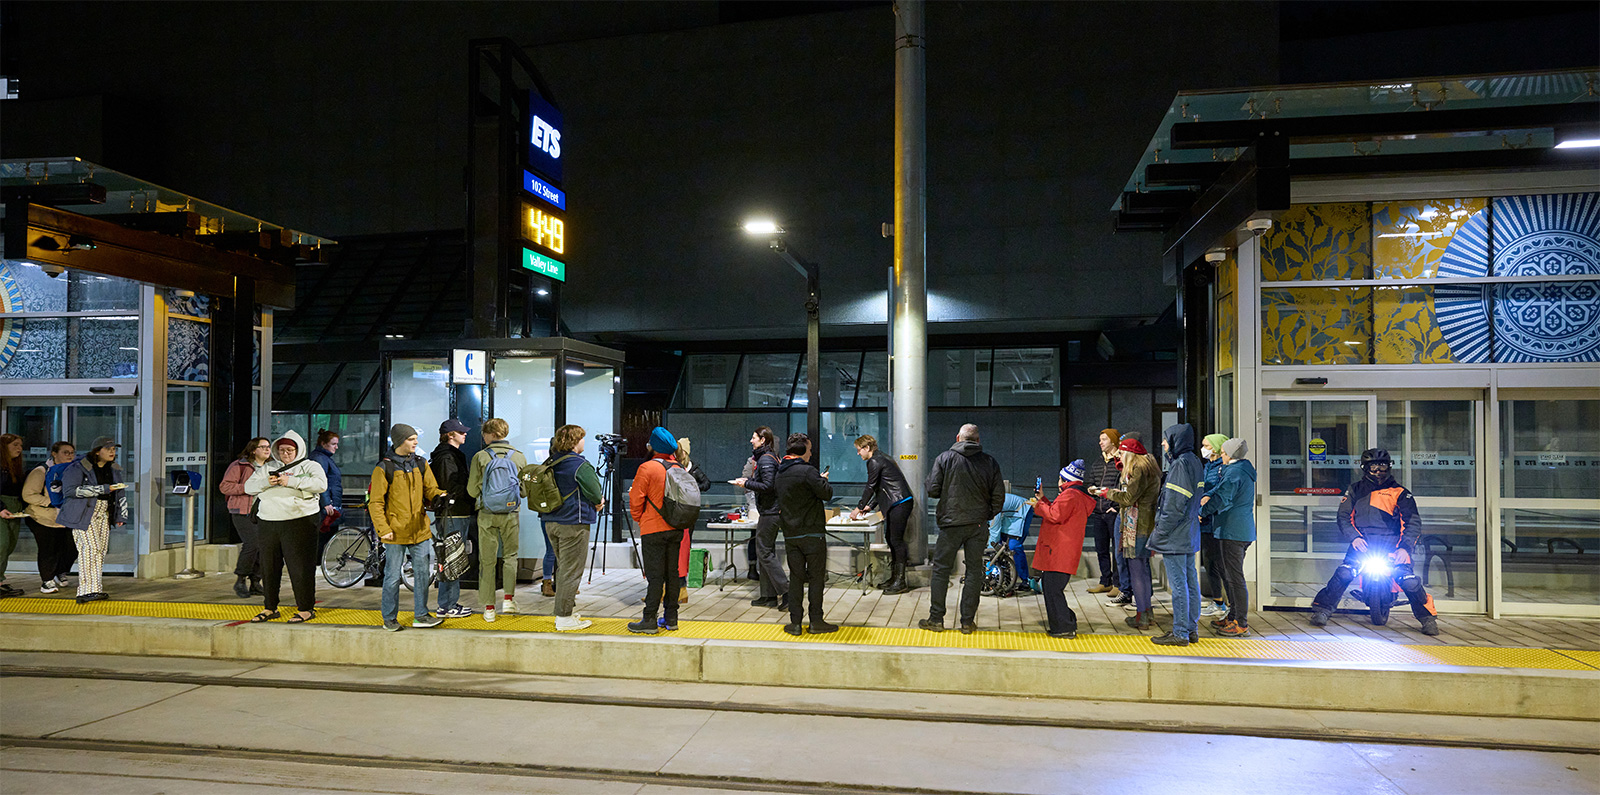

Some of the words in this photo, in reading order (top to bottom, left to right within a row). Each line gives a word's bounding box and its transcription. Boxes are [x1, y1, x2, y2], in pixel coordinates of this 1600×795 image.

[531, 115, 561, 159] ETS
[532, 179, 542, 194] 102
[543, 185, 559, 204] Street
[530, 208, 564, 254] 4:49
[530, 254, 546, 273] Valley
[547, 261, 559, 275] Line
